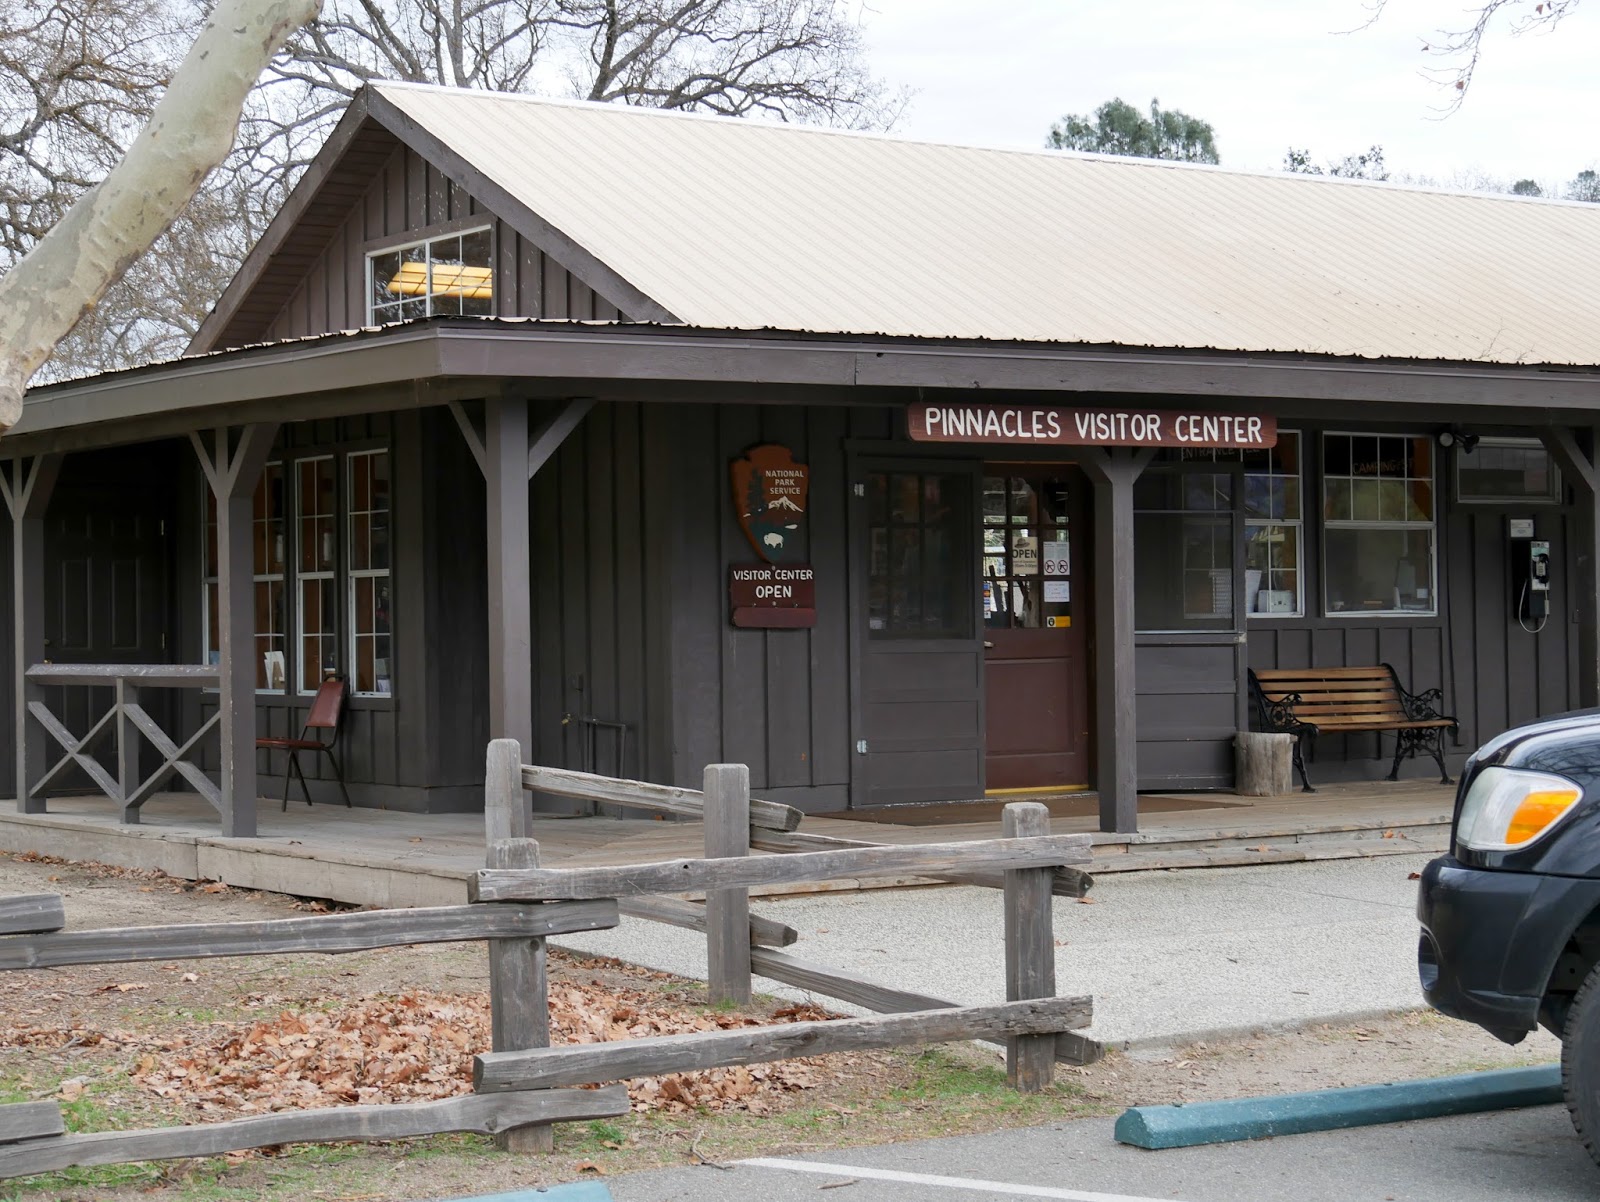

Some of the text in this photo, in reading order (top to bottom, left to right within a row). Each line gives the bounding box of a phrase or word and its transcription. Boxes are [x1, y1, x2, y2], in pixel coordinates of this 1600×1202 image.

[924, 407, 1263, 443] PINNACLES VISITOR CENTER
[765, 470, 804, 478] NATIONAL
[769, 487, 801, 495] SERVICE
[1012, 549, 1037, 559] OPEN
[733, 569, 813, 581] VISITOR CENTER
[755, 585, 792, 599] OPEN
